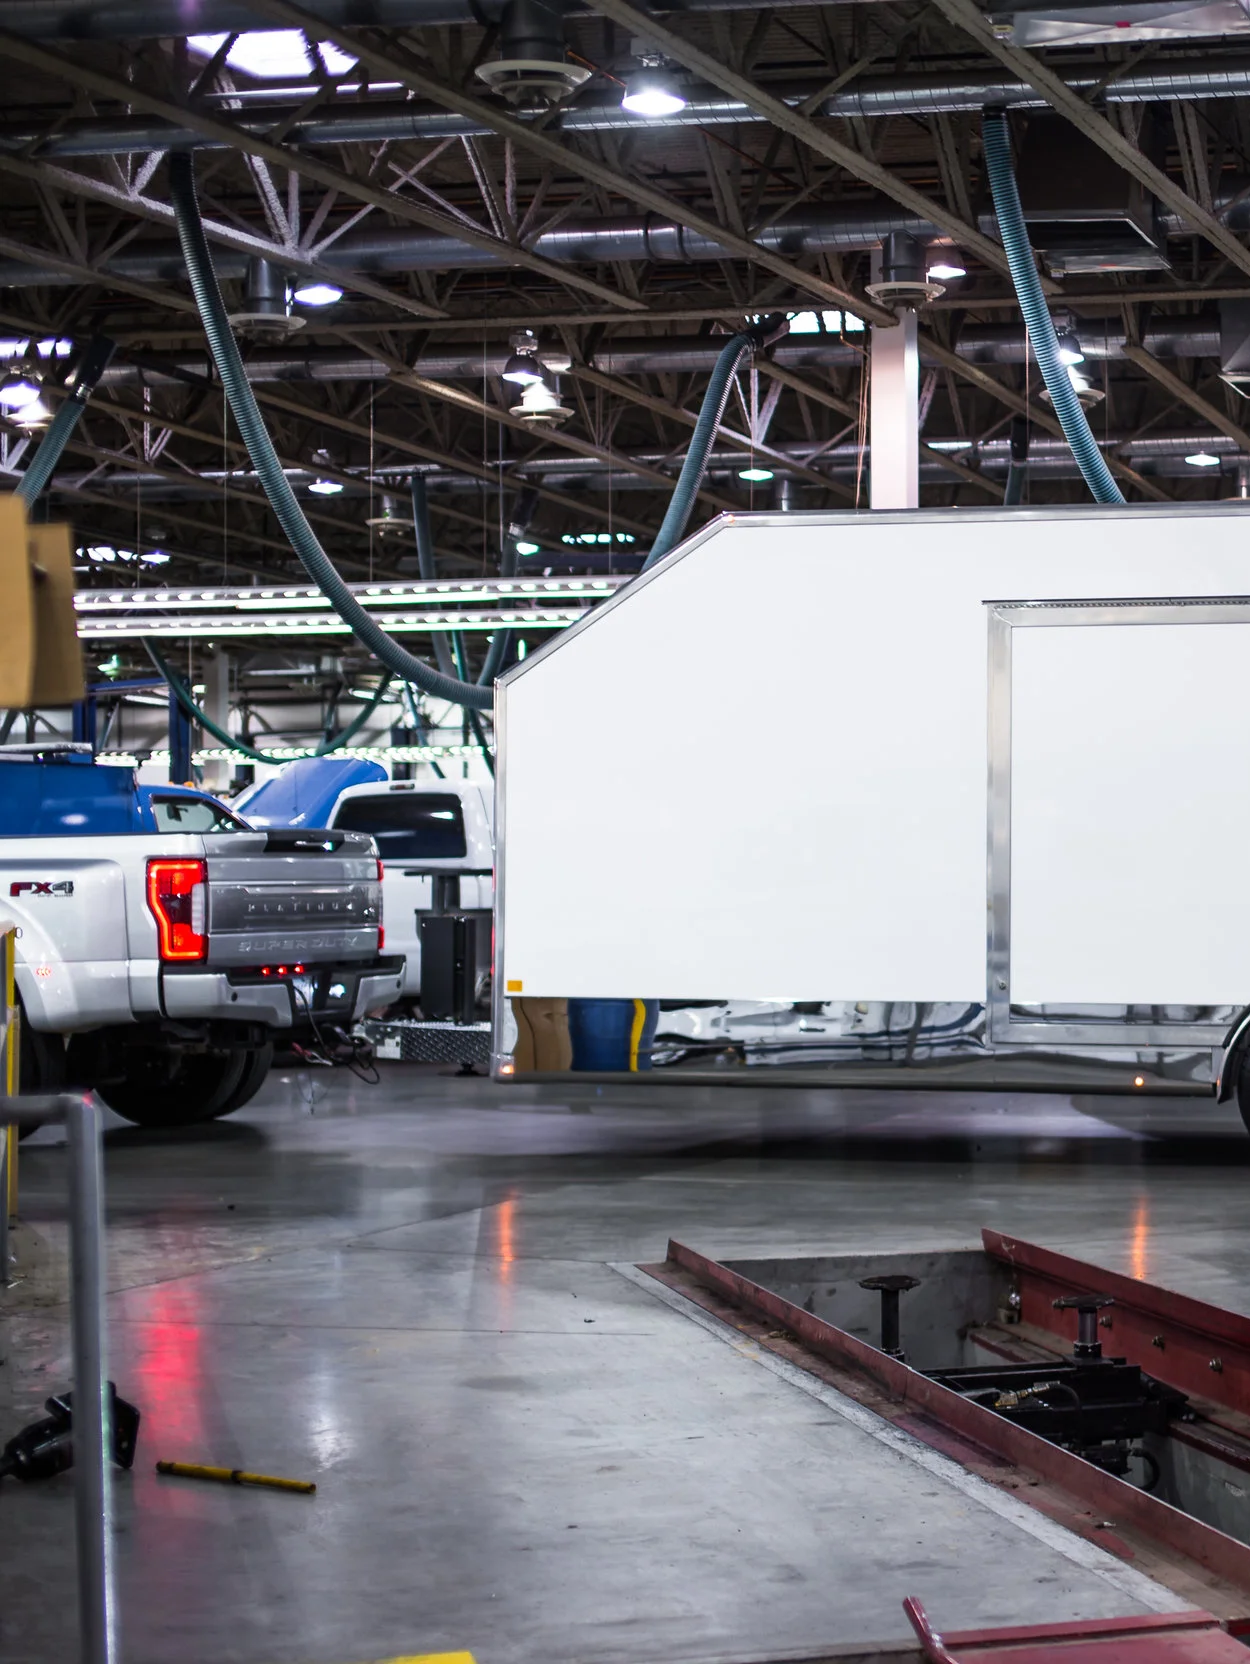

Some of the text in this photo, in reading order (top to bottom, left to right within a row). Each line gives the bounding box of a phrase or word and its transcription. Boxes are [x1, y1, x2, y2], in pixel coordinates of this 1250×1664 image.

[10, 881, 74, 897] FX4
[238, 936, 357, 952] SUPER DUTY
